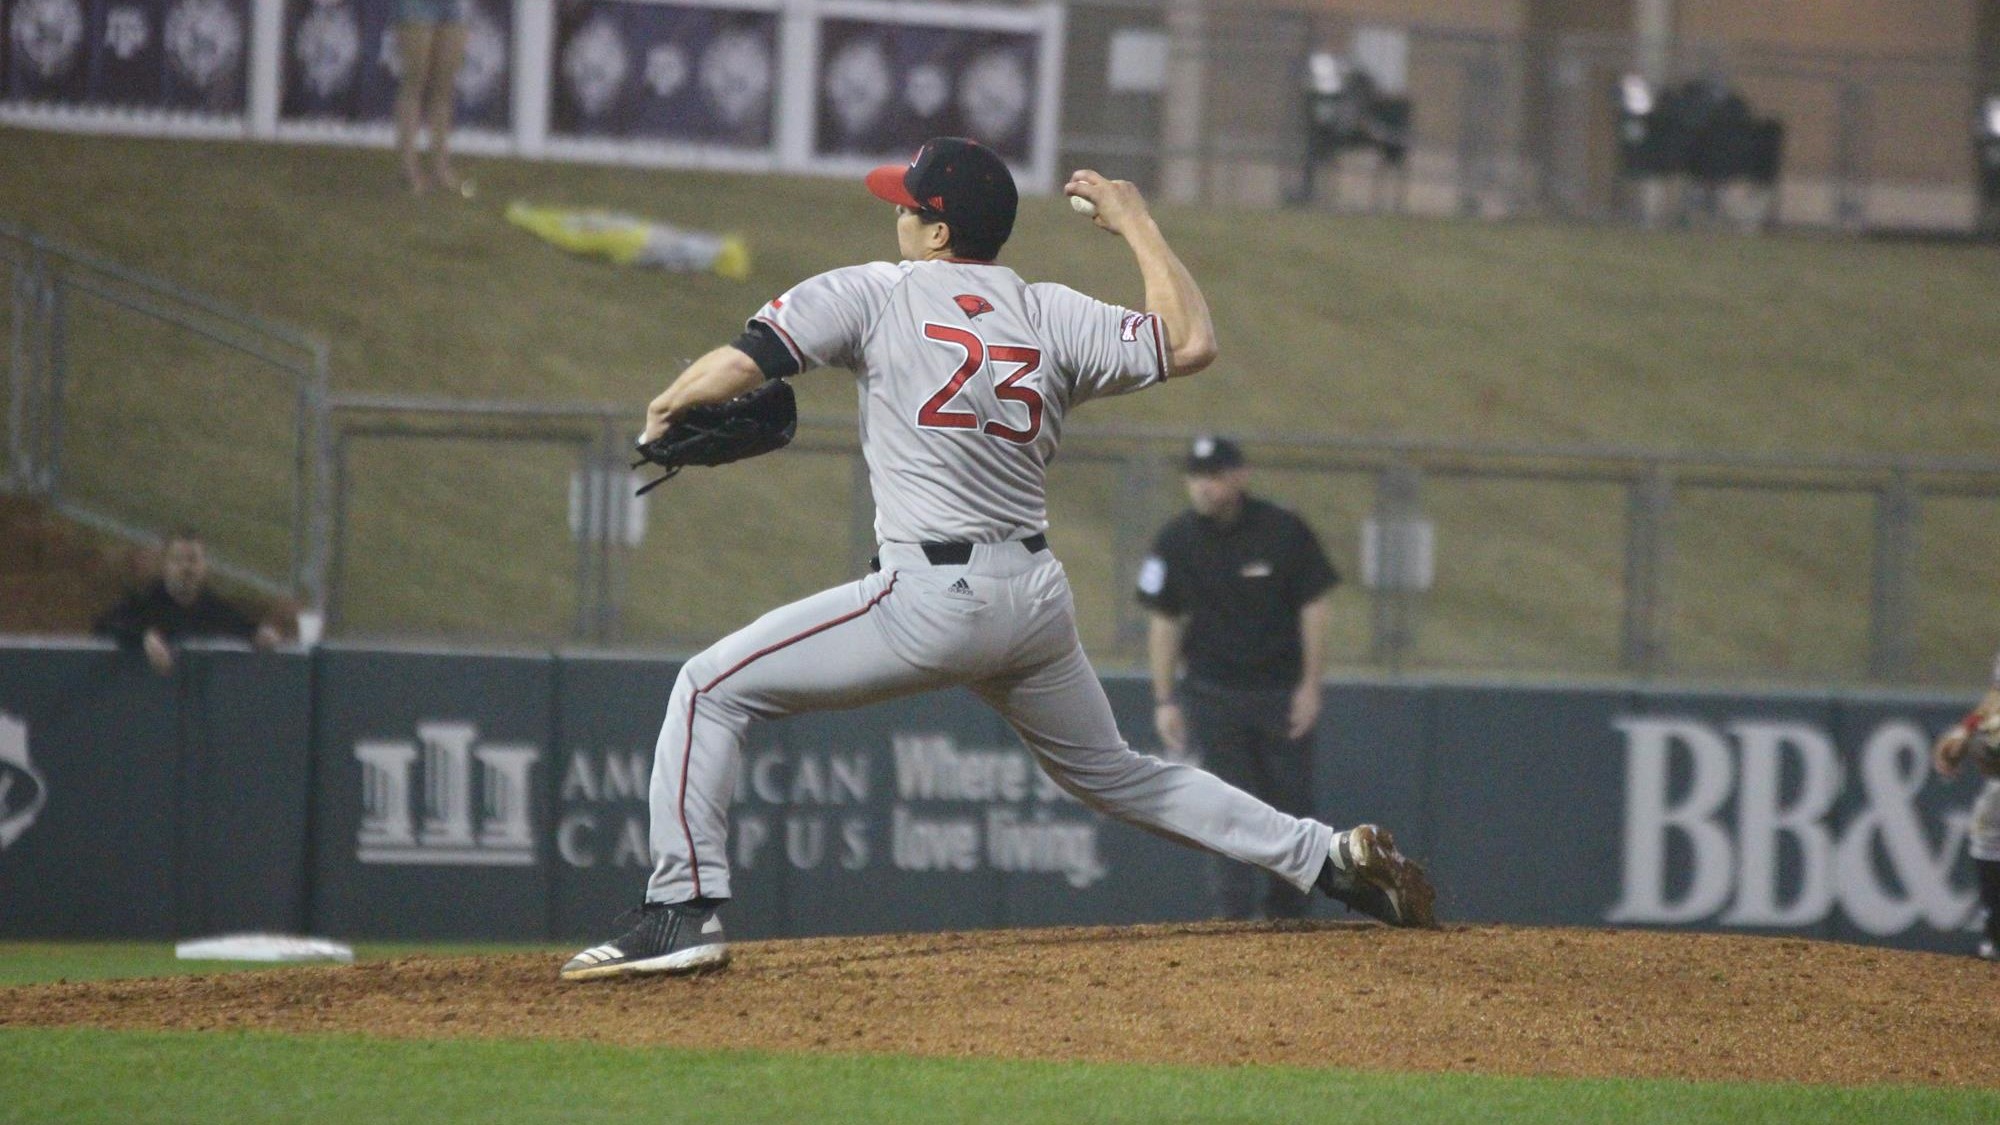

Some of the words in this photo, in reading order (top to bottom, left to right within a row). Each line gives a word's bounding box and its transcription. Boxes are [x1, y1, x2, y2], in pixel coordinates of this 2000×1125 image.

[916, 321, 1045, 446] 23
[559, 750, 870, 805] AMICAN
[892, 732, 1028, 800] Where
[556, 812, 870, 872] CAPUS
[892, 806, 978, 872] love
[1603, 715, 1985, 937] BB&
